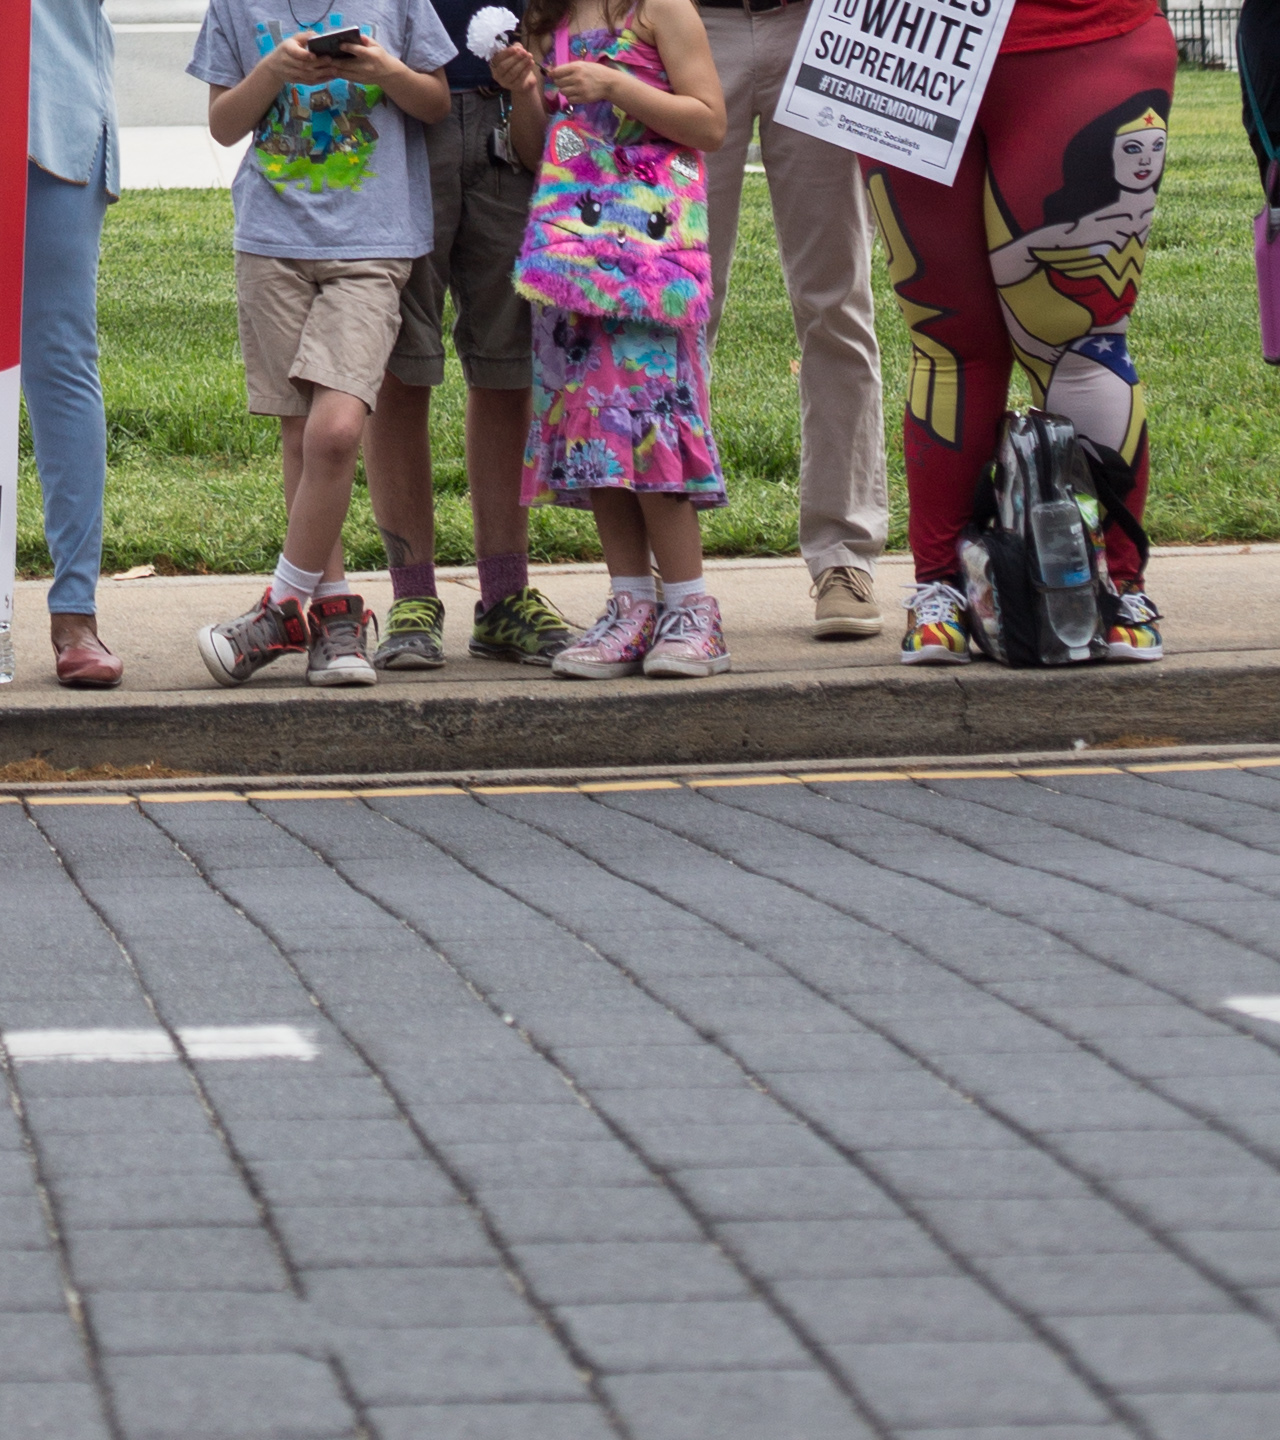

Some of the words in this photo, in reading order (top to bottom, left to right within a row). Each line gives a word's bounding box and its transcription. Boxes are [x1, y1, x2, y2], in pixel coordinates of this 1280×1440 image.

[814, 30, 965, 107] SUPREMACY
[818, 74, 938, 132] #TEARTHEMDOWN
[839, 114, 883, 137] Democratic
[884, 130, 920, 150] Socialists
